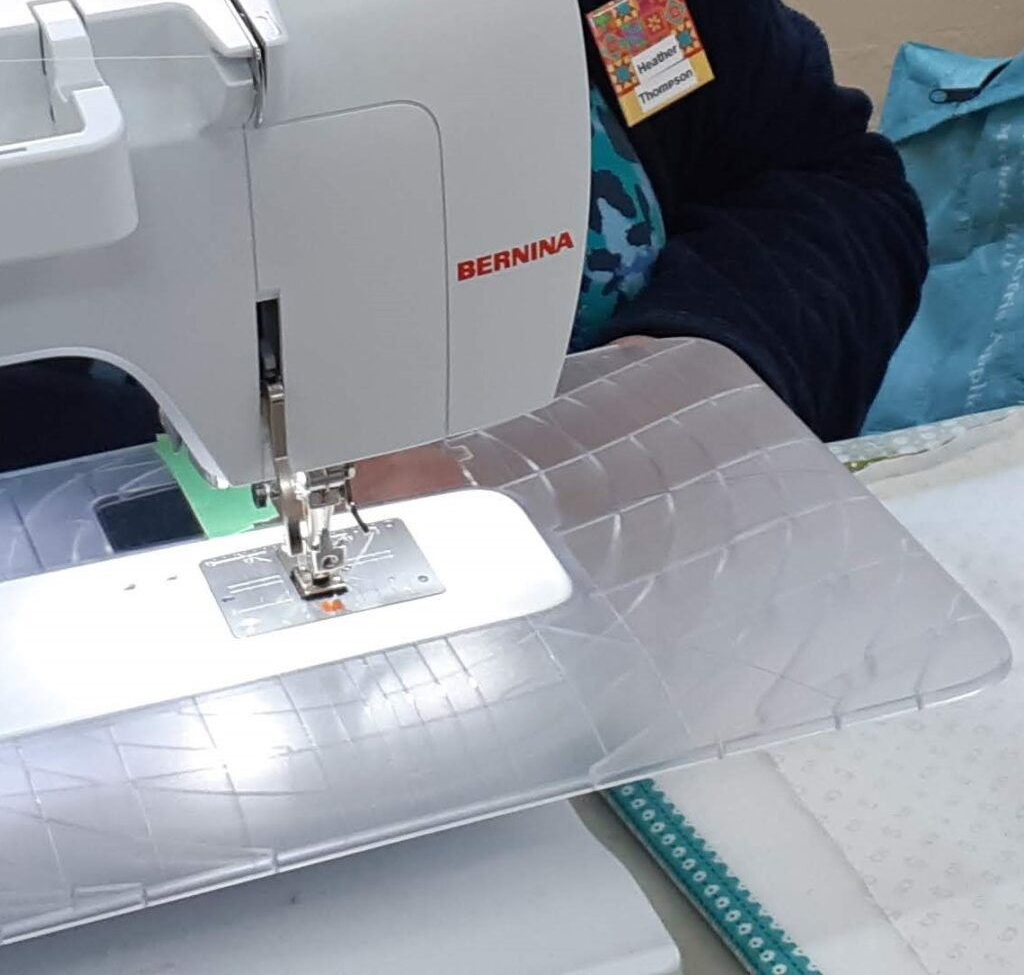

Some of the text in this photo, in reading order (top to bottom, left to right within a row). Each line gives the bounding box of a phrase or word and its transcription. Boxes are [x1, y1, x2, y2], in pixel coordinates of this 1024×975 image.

[637, 45, 678, 74] Heather
[639, 69, 693, 103] Thompson
[457, 231, 574, 281] BERNINA
